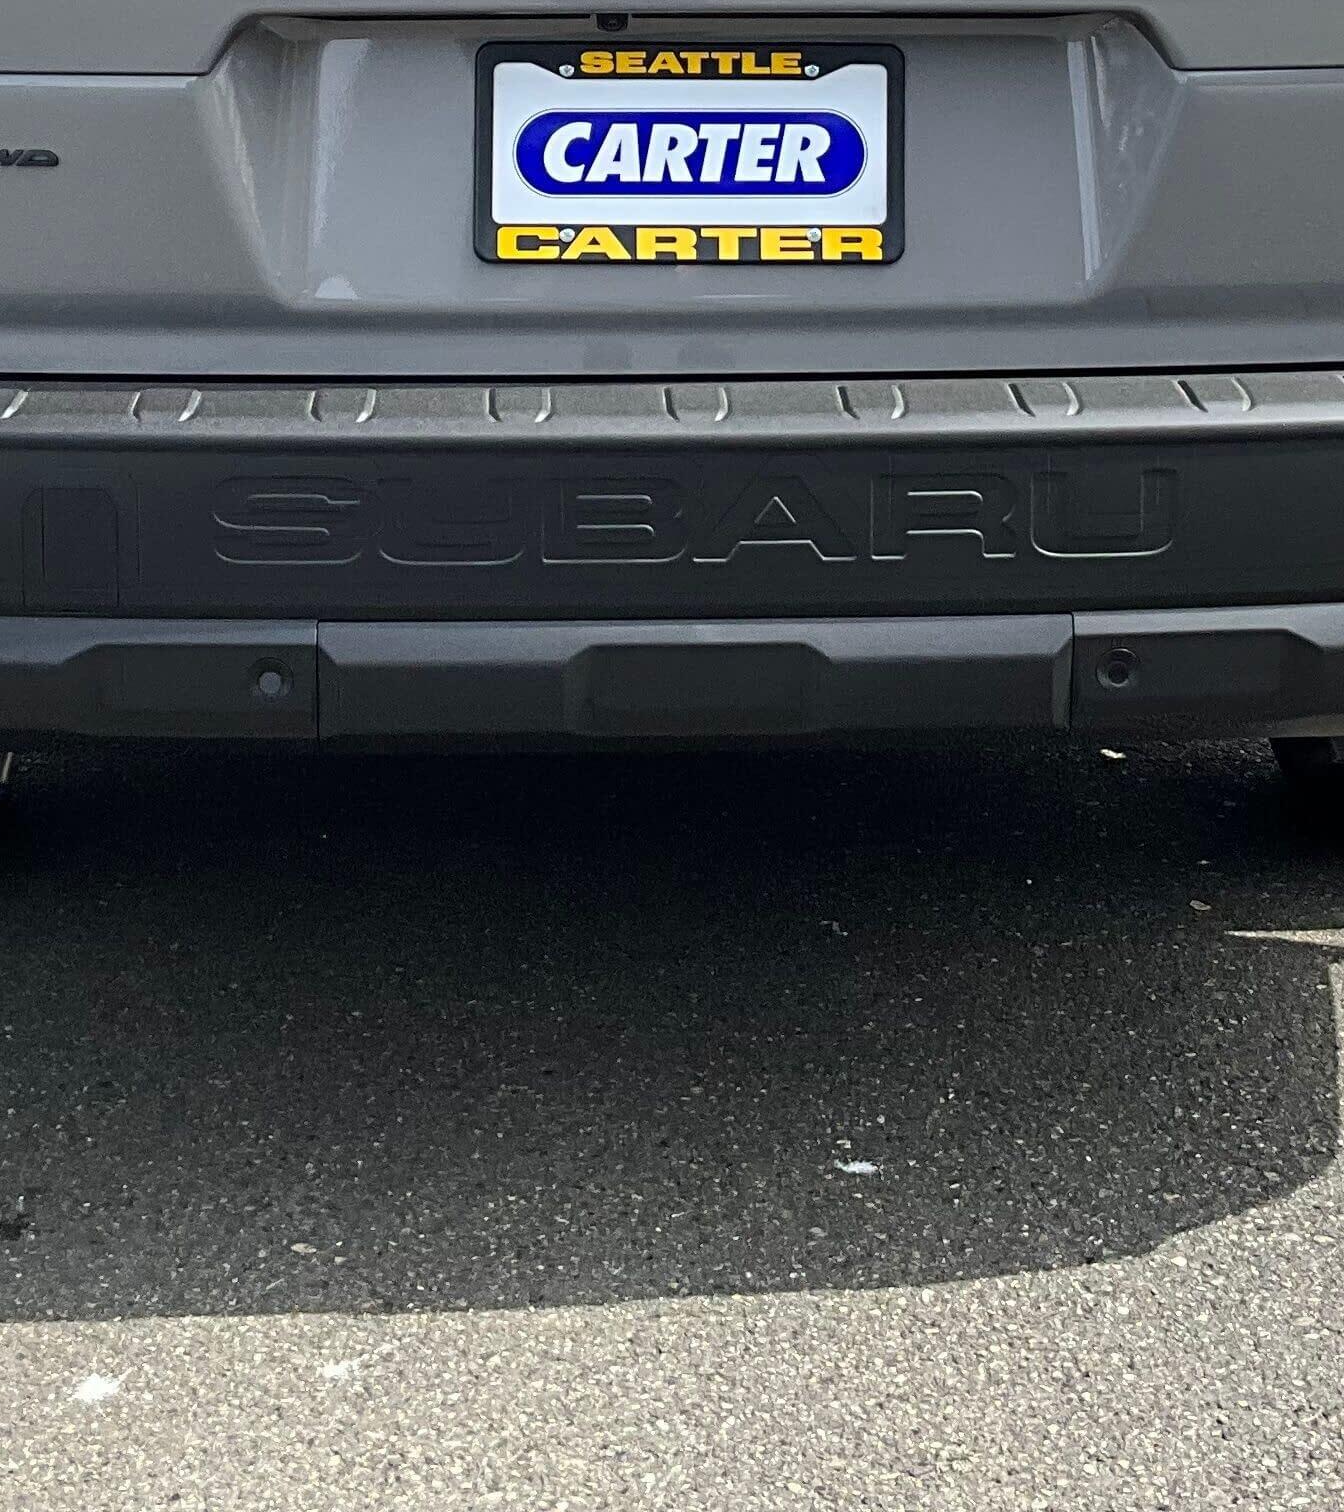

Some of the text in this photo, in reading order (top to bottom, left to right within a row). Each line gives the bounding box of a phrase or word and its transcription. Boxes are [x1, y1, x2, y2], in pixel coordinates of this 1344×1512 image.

[579, 50, 802, 76] SEATTLE
[542, 121, 832, 184] CARTER
[496, 226, 884, 261] CARTER
[211, 468, 1179, 567] SUBARU
